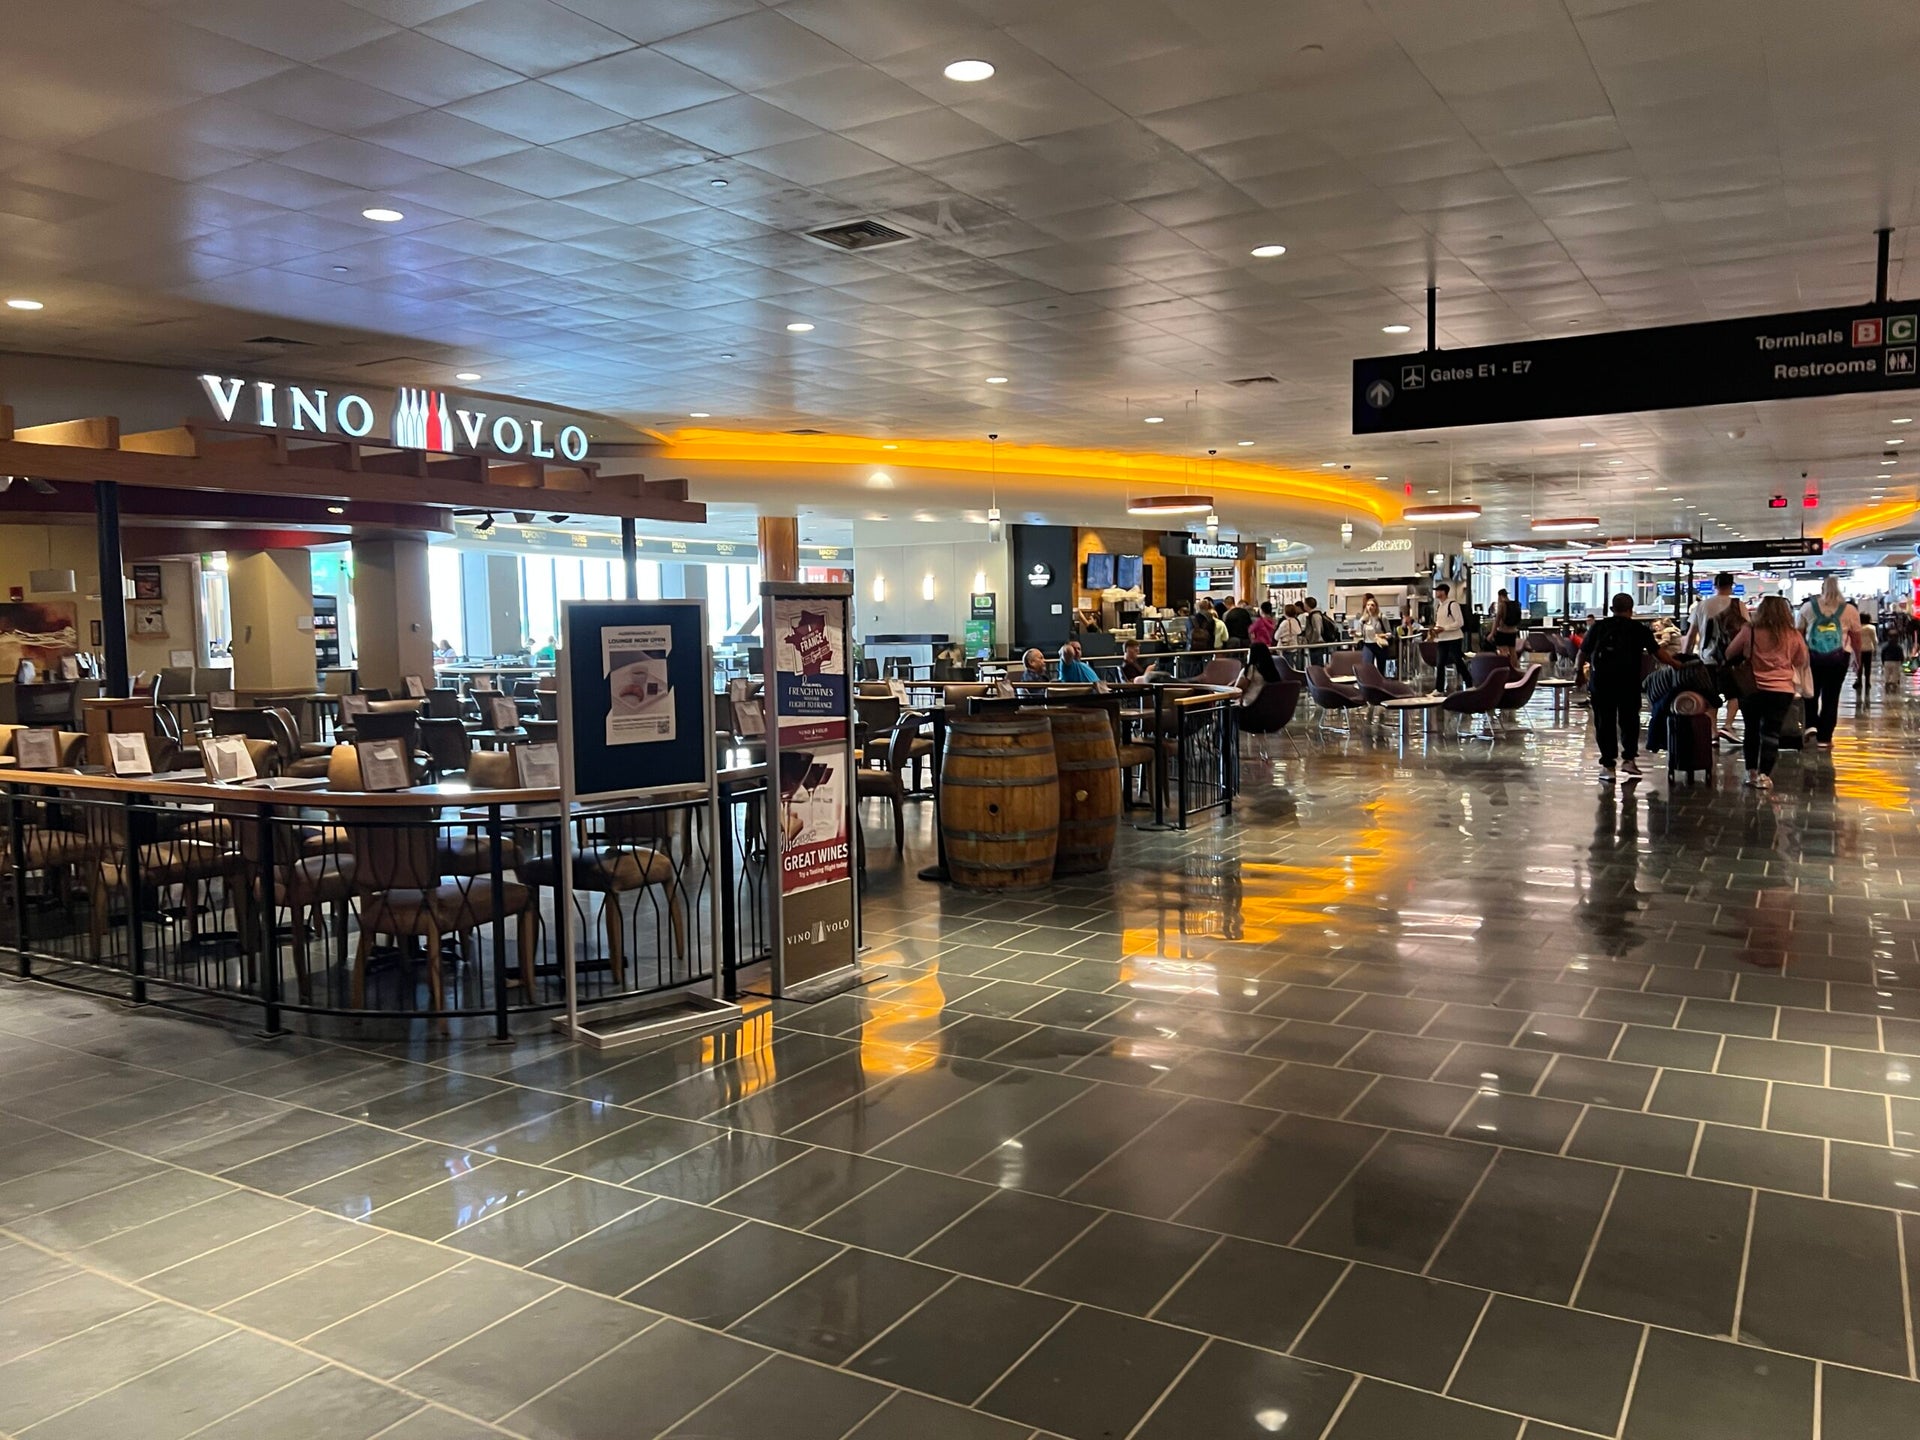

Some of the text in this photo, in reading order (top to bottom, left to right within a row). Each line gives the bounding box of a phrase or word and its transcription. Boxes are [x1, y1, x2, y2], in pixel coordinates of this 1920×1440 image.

[1755, 319, 1912, 350] Terminals B C
[1430, 367, 1474, 382] Gates
[1478, 363, 1496, 377] E1
[1512, 360, 1532, 374] E7
[1774, 358, 1877, 379] Restrooms
[201, 373, 589, 462] VINO VOLO
[800, 632, 824, 653] FRANCE
[788, 686, 834, 697] FRENCH WINES
[784, 843, 849, 872] GREAT WINES
[787, 919, 850, 945] VINO VOLO
